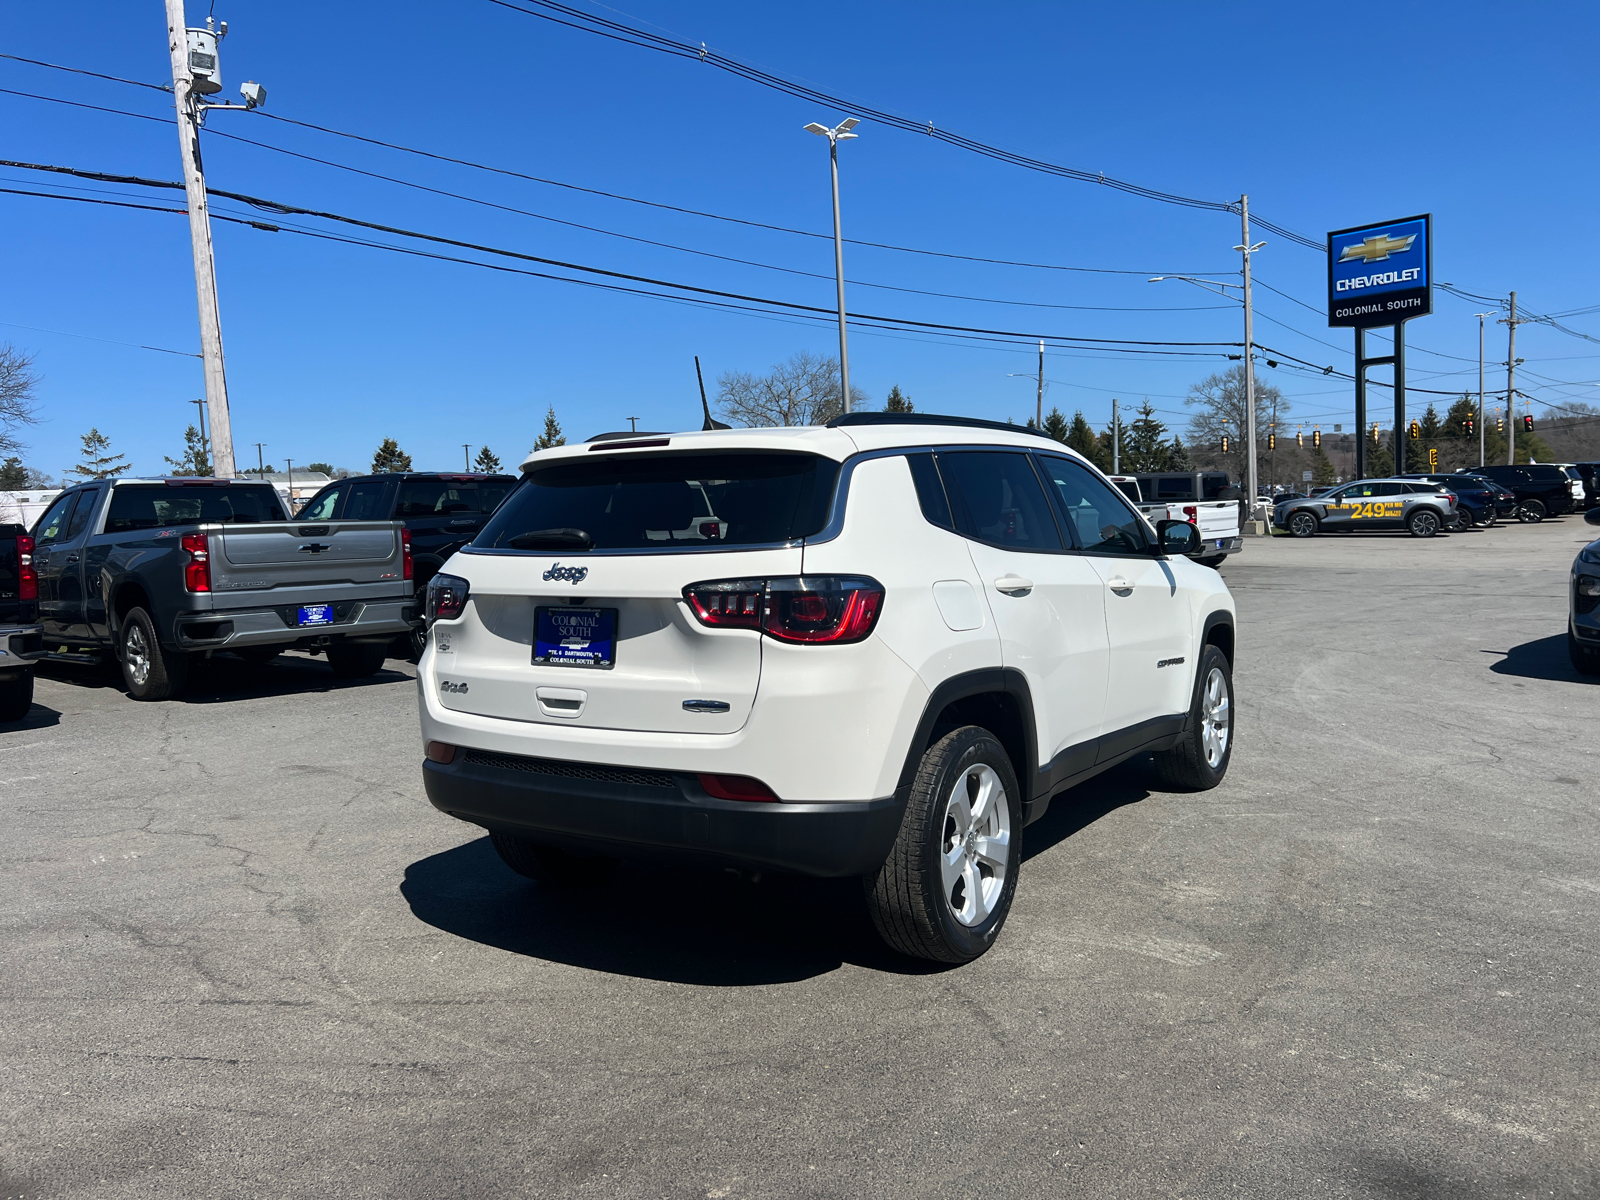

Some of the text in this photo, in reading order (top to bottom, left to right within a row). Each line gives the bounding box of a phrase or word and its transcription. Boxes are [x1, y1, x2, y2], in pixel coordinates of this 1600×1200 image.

[1336, 267, 1421, 292] CHEVROLET
[1336, 298, 1421, 317] COLONIAL SOUTH
[542, 561, 589, 586] Jeep
[551, 615, 599, 627] COLONIAL
[558, 626, 592, 637] SOUTH
[549, 656, 595, 666] COLONIAL SOUTH
